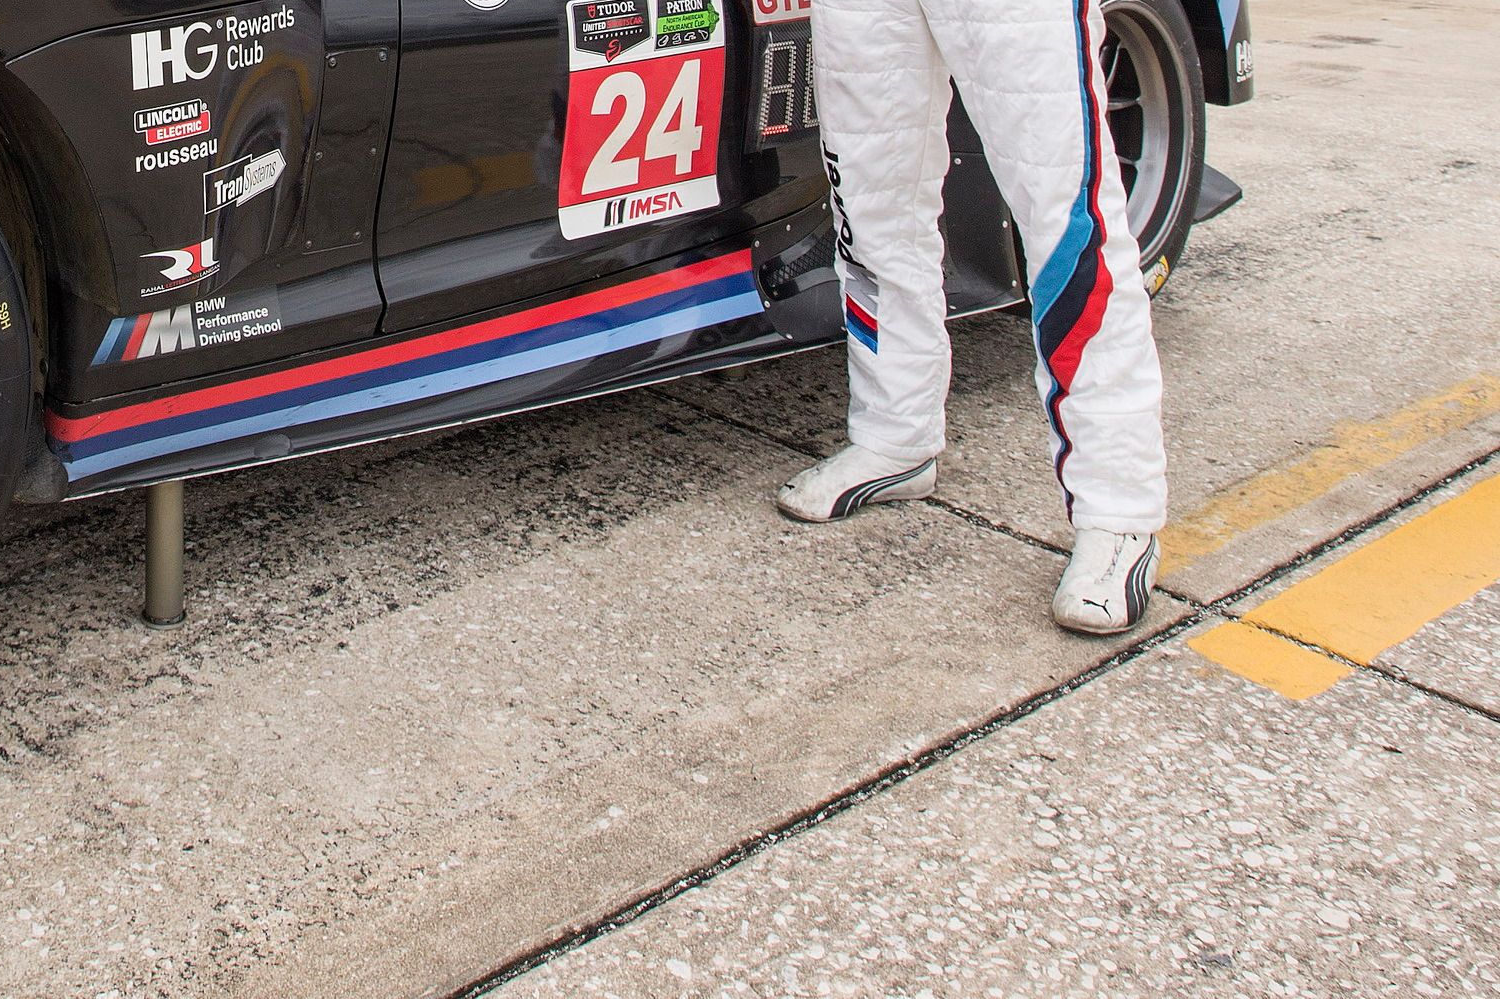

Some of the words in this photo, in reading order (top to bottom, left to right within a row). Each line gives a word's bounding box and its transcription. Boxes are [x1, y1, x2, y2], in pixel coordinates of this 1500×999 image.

[597, 1, 636, 16] TUDOR
[583, 21, 606, 33] UNITED
[662, 23, 693, 33] ENDURANCE
[694, 20, 705, 28] CUP
[130, 21, 218, 91] IHG
[226, 5, 295, 41] Rewards
[226, 41, 264, 70] Club
[139, 102, 199, 129] LINCOLN
[581, 59, 703, 196] 24
[156, 121, 202, 140] ELECTRIC
[135, 138, 218, 173] rousseau
[214, 158, 277, 204] TranSystems
[629, 191, 684, 220] IMSA
[141, 284, 165, 294] RAHAL
[195, 297, 226, 313] BMW
[197, 306, 269, 329] Performance
[200, 329, 241, 346] Driving
[243, 319, 282, 338] School
